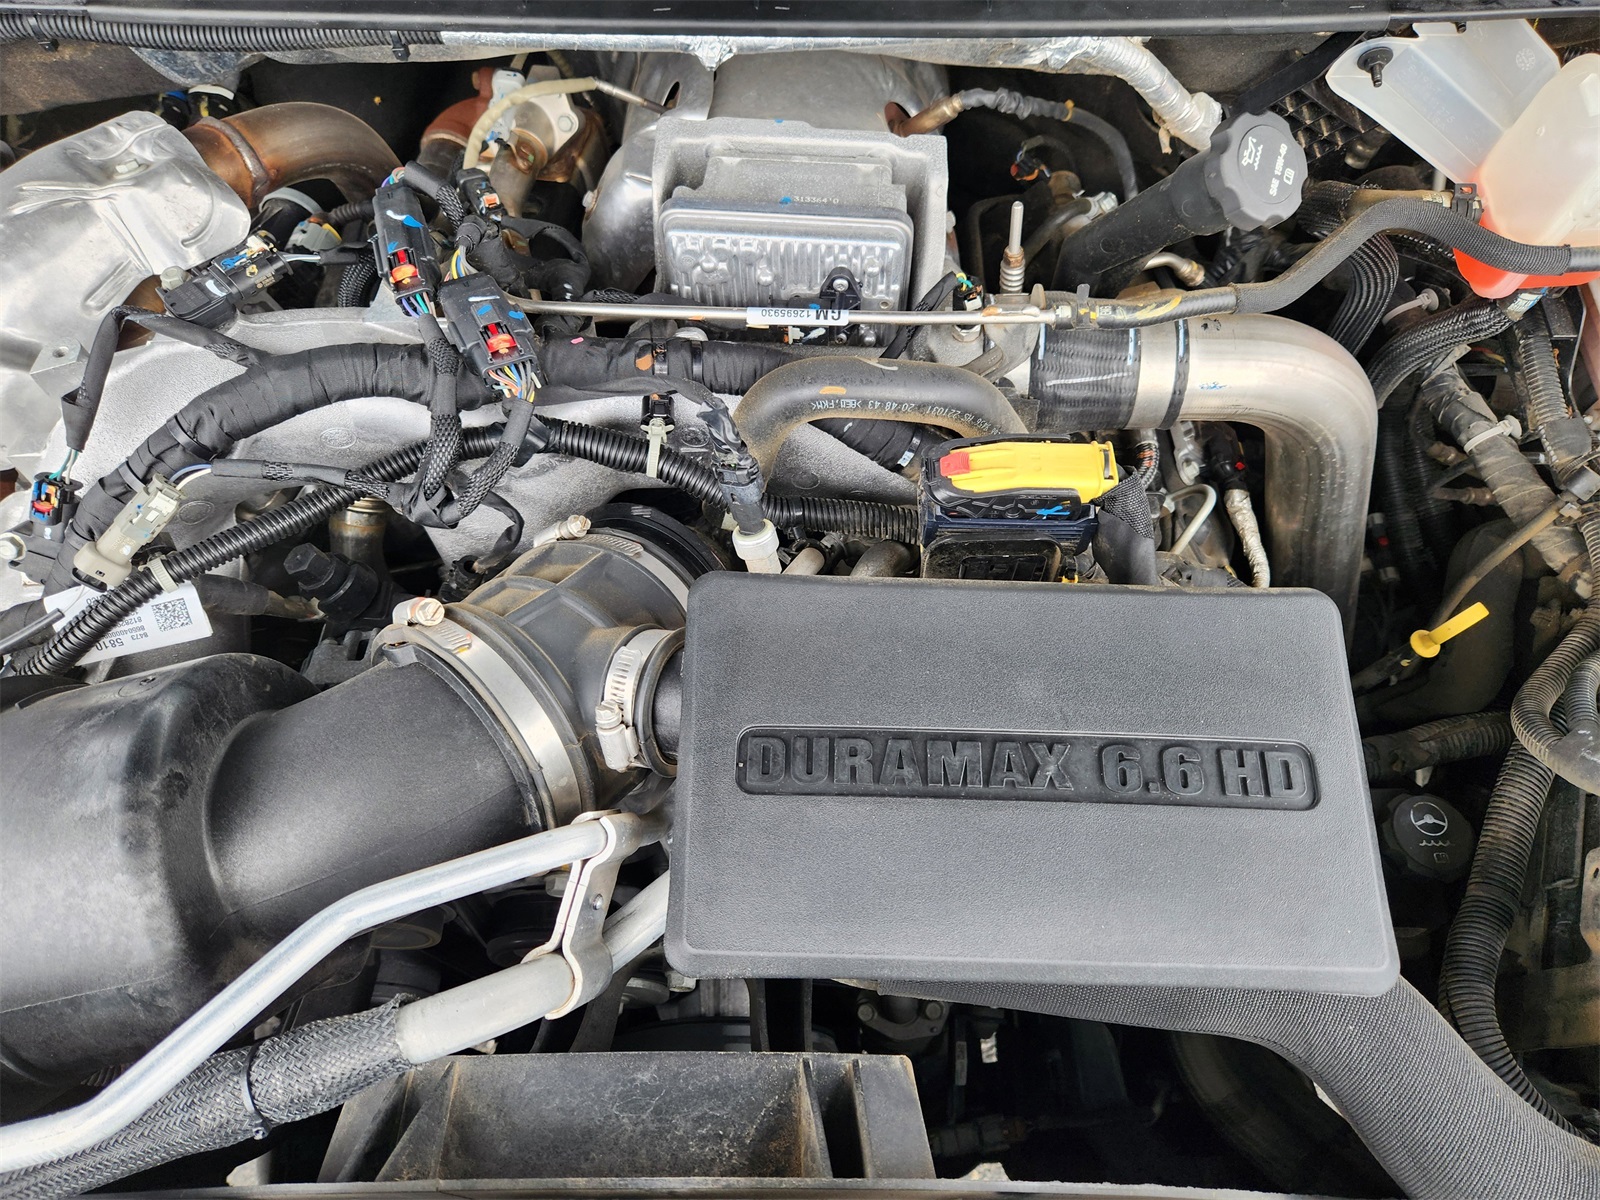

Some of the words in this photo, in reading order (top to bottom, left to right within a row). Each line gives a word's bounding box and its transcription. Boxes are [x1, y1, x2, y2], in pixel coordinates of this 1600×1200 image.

[1274, 143, 1288, 176] 15W-40
[1269, 177, 1280, 197] SAE
[761, 308, 811, 318] 12695930
[815, 309, 841, 321] GM
[867, 399, 914, 412] 20:48:43
[131, 632, 149, 641] 8473
[95, 637, 125, 651] 5810
[744, 735, 1074, 792] DURAMAX
[1101, 743, 1205, 796] 6.6
[1217, 747, 1308, 800] HD
